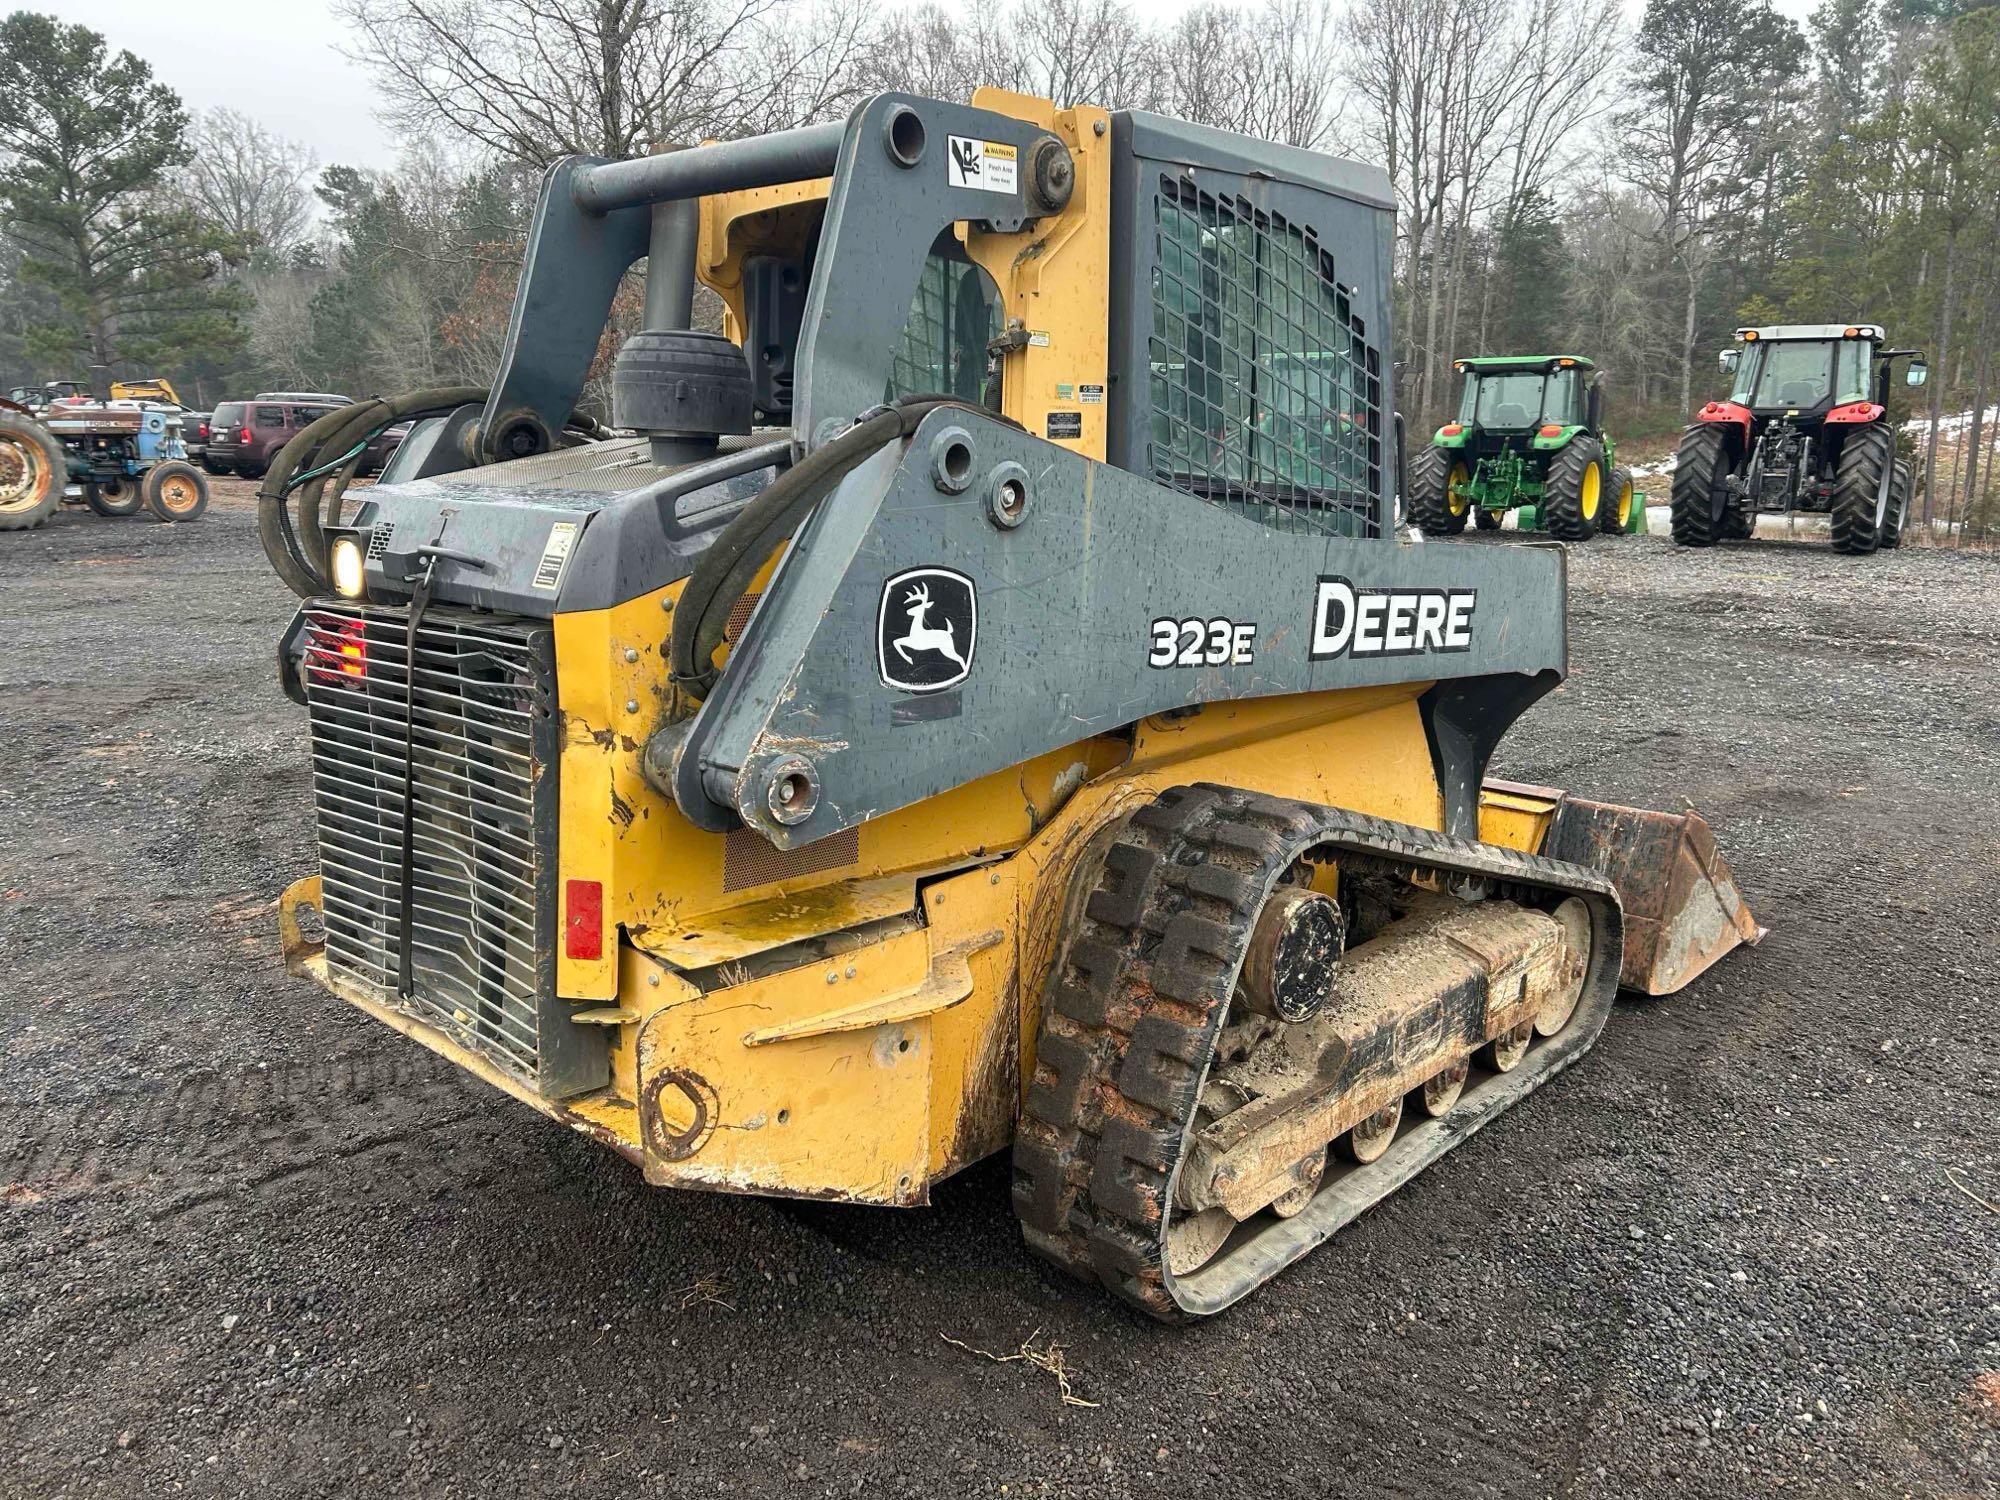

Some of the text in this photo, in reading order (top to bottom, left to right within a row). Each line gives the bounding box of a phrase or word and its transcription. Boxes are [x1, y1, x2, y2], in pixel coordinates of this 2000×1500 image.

[990, 147, 1014, 157] WARNING
[1150, 579, 1475, 667] 323E DEERE
